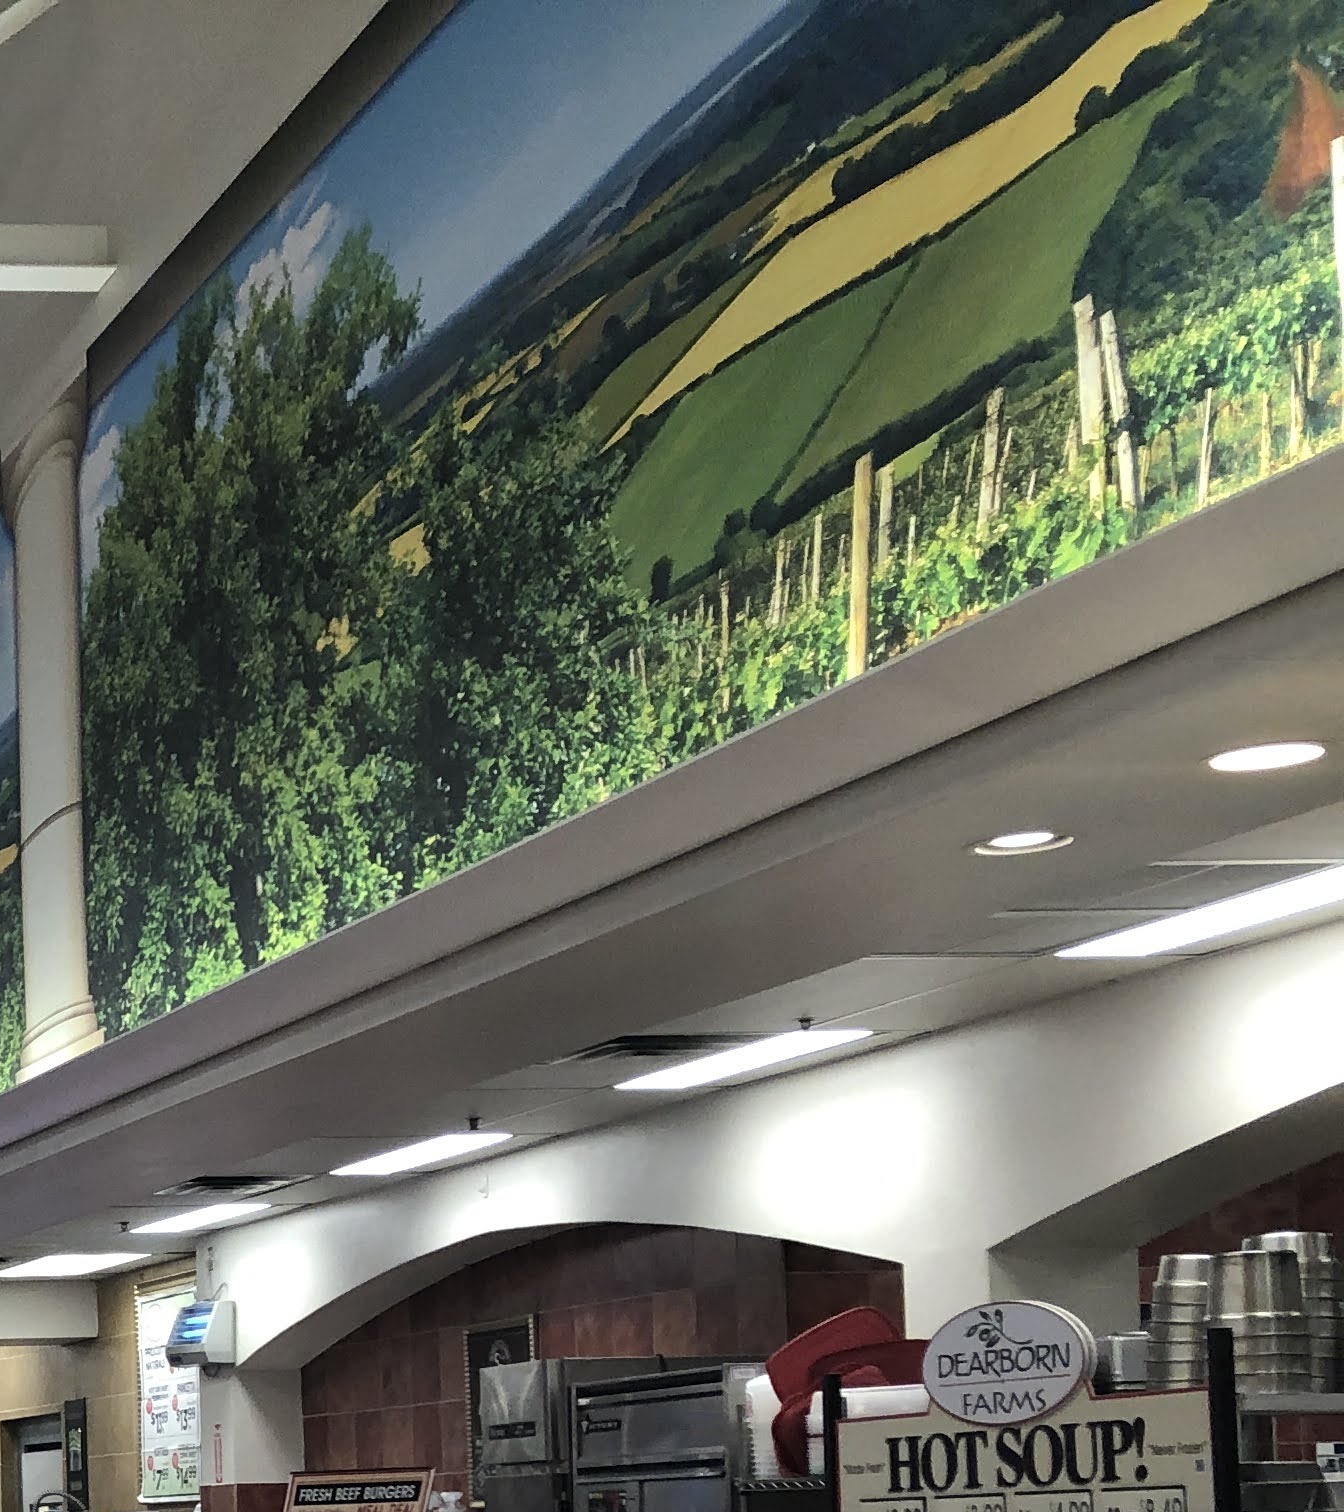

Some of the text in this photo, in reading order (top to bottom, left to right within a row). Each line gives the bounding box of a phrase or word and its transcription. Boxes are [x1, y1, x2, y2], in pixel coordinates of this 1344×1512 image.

[937, 1342, 1070, 1378] DEARBORN
[963, 1388, 1047, 1416] FARMS
[885, 1416, 1147, 1494] HOT SOUP!
[299, 1485, 416, 1502] FRESH BEEF BURGERS
